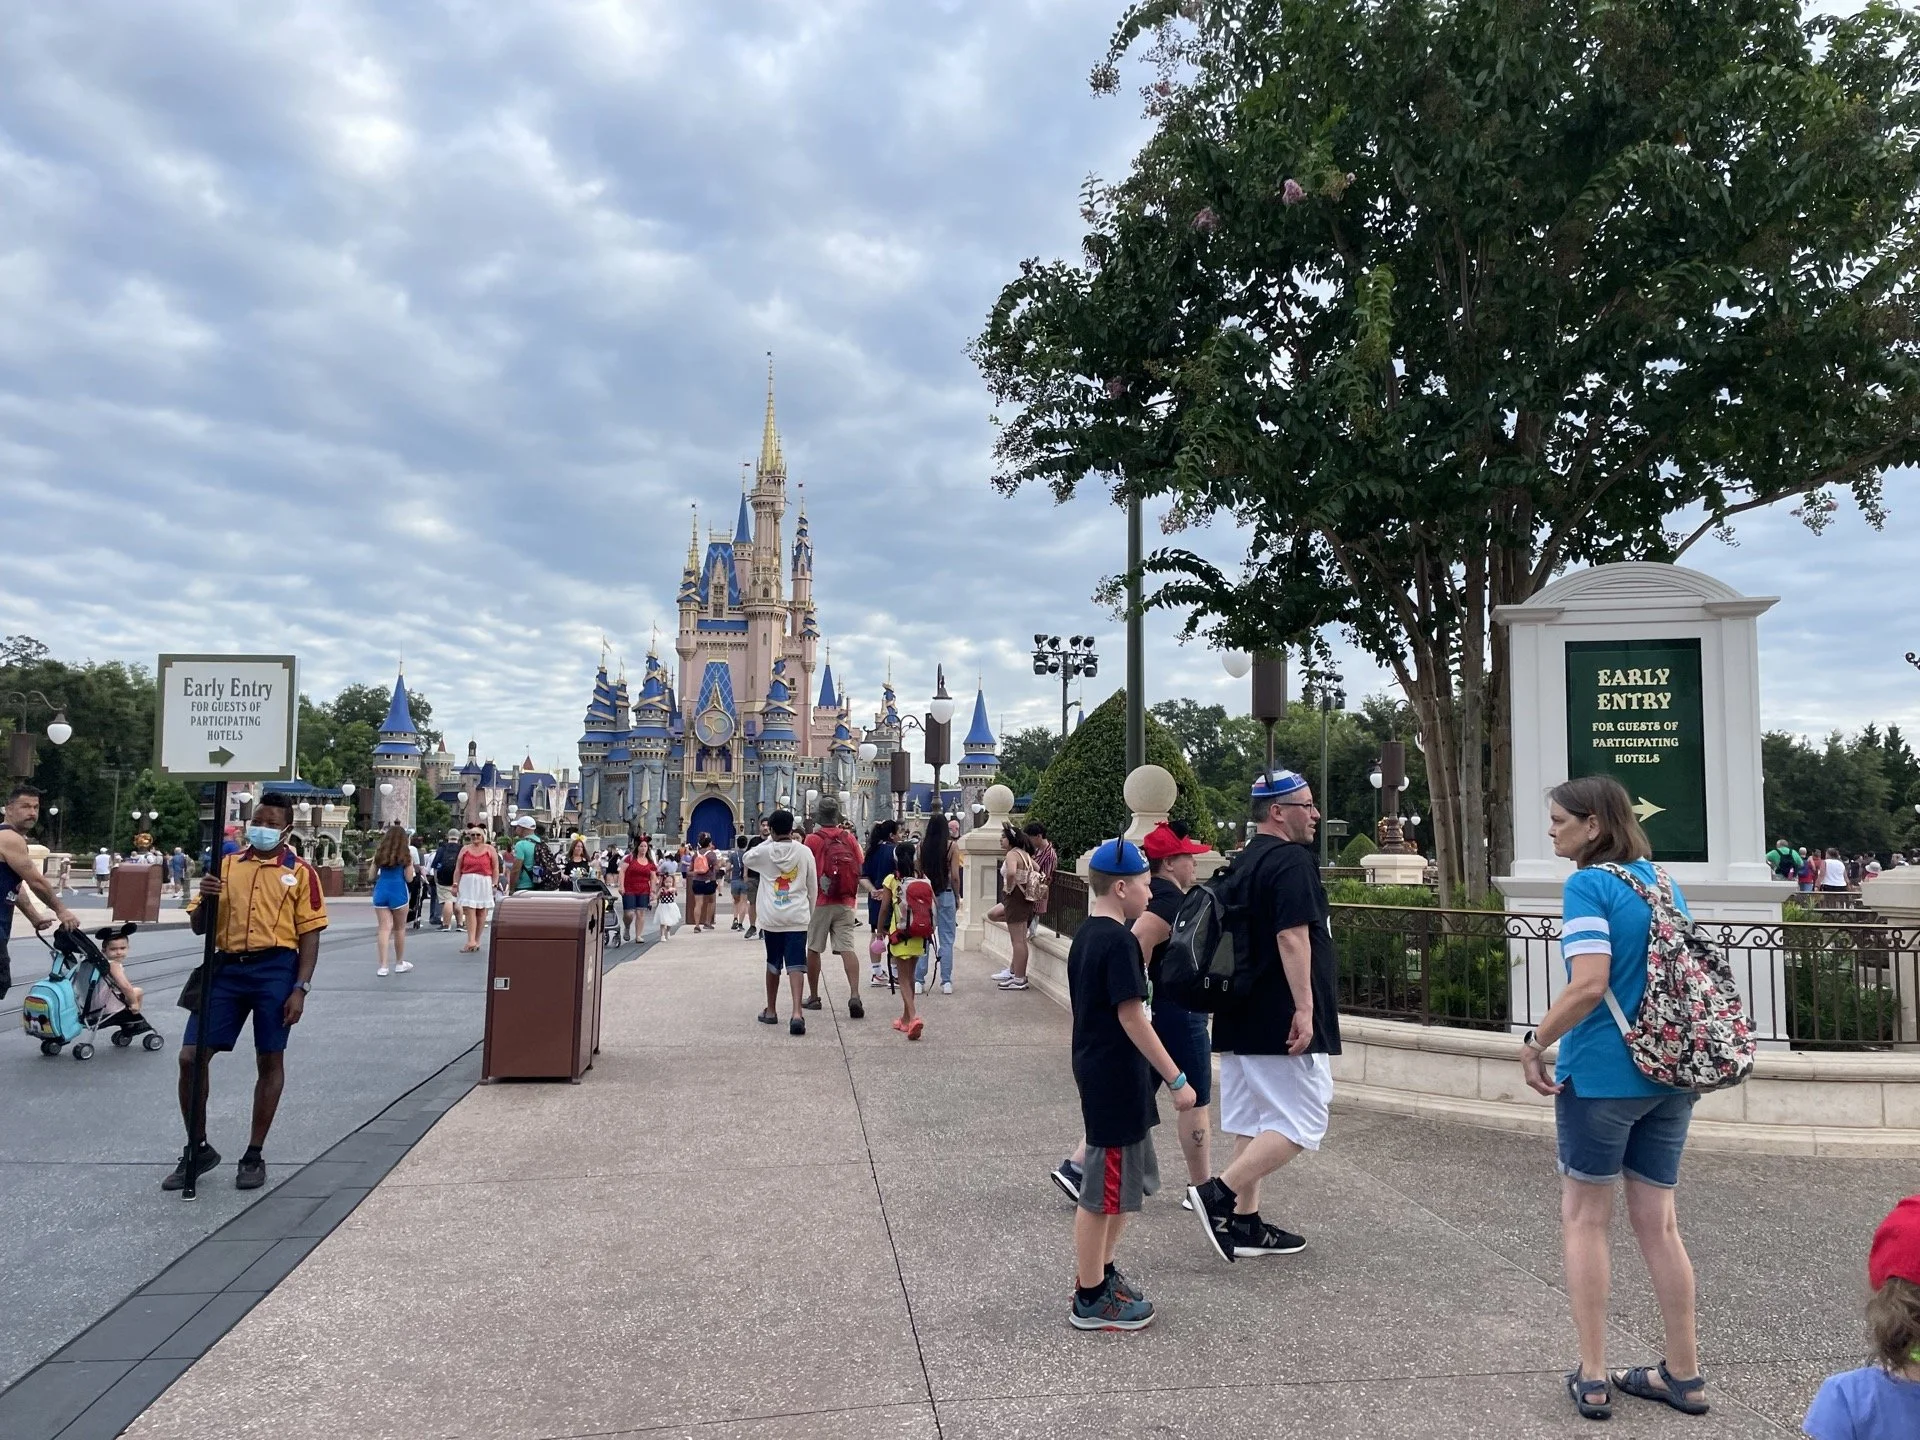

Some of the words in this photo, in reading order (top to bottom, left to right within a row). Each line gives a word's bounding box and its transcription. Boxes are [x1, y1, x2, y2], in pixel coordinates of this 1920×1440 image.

[1597, 668, 1670, 686] EARLY
[184, 677, 224, 700] Early
[231, 678, 272, 701] Entry
[1597, 692, 1672, 710] ENTRY
[191, 702, 209, 711] FOR
[212, 702, 246, 711] GUESTS
[250, 702, 261, 711] OF
[191, 716, 261, 726] PARTICIPATING
[1592, 722, 1614, 732] FOR
[1617, 722, 1660, 731] GUESTS
[1664, 722, 1679, 731] OF
[207, 730, 243, 740] HOTELS
[1592, 738, 1679, 748] PARTICIPATING
[1615, 754, 1660, 763] HOTELS
